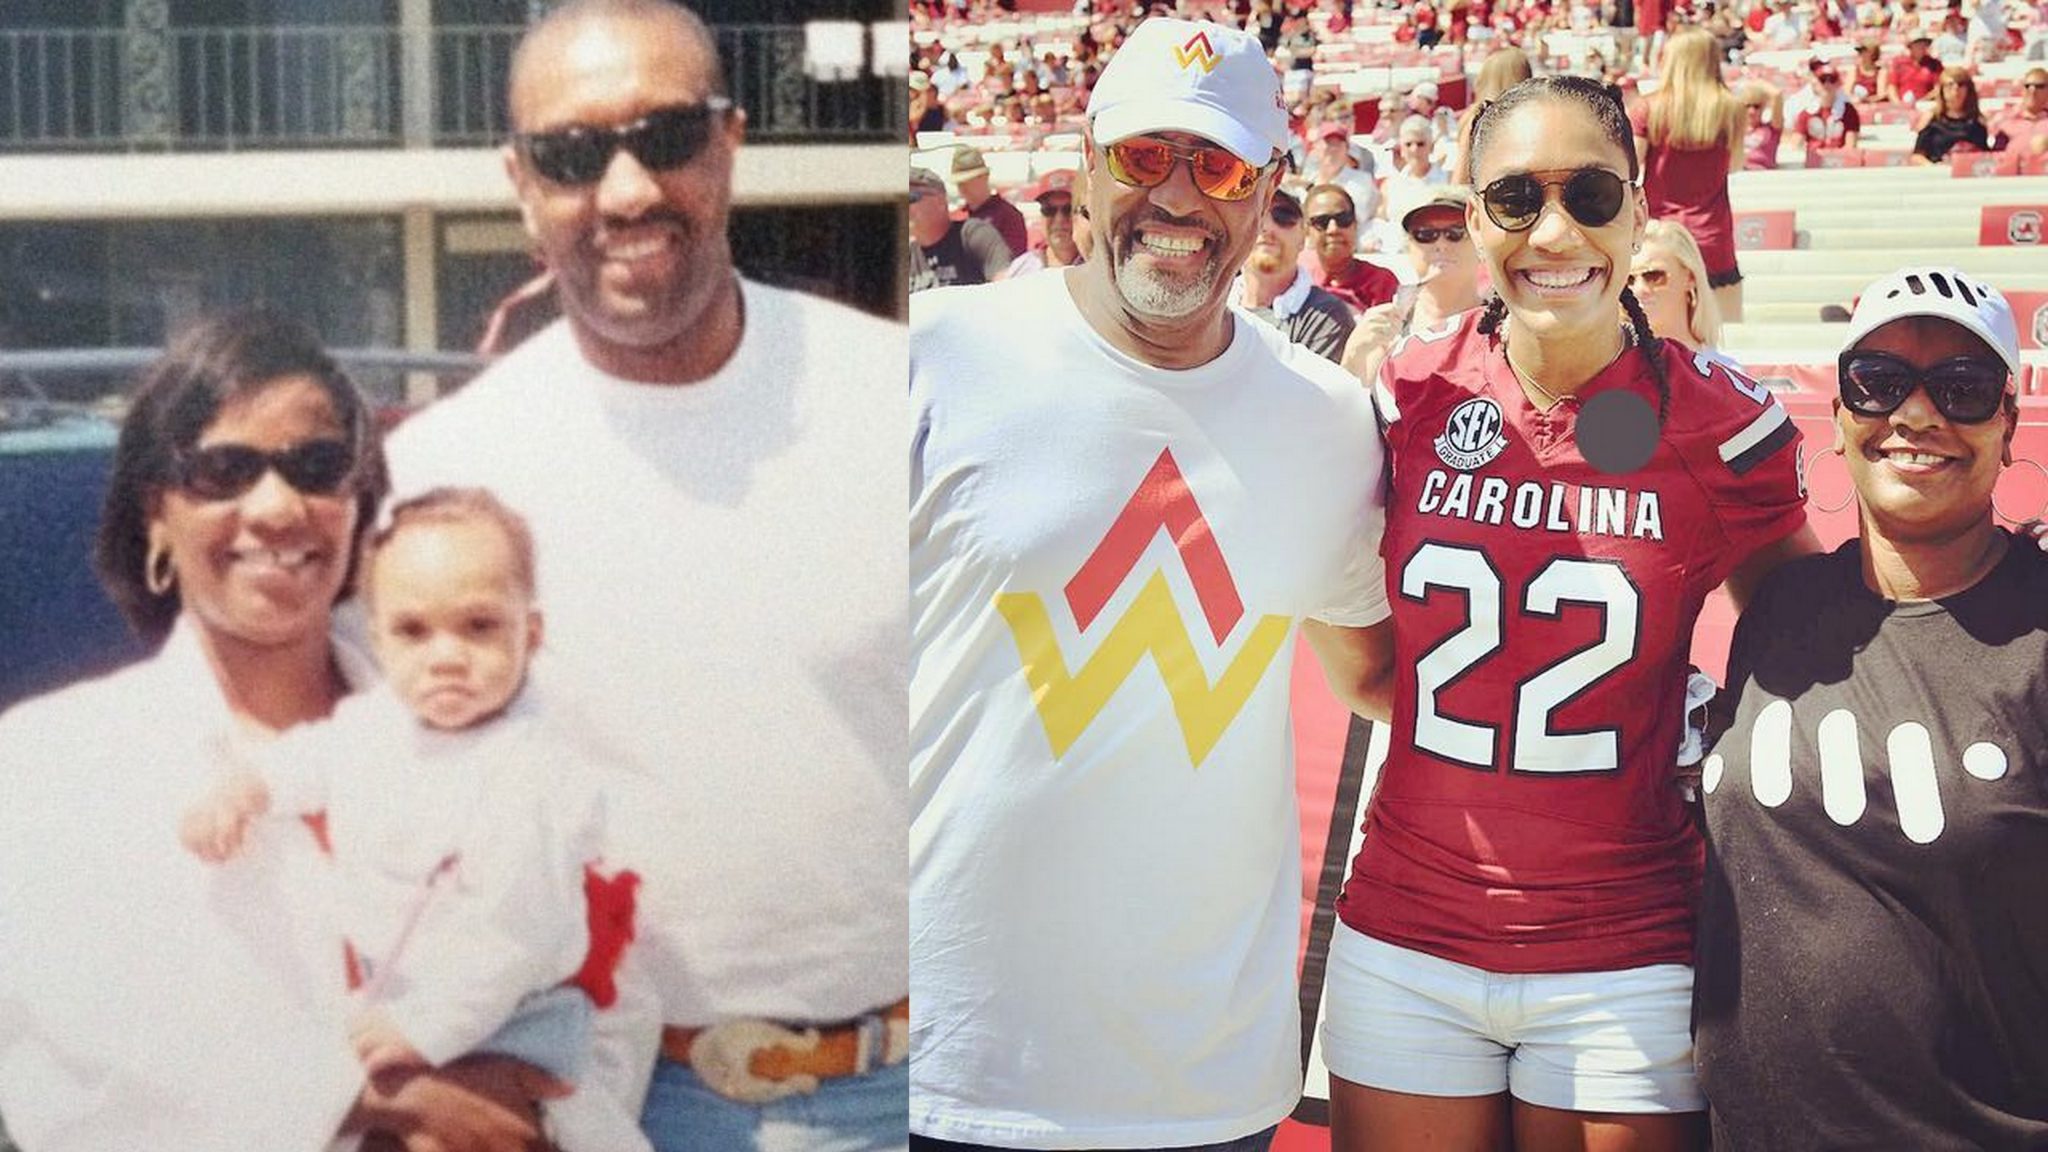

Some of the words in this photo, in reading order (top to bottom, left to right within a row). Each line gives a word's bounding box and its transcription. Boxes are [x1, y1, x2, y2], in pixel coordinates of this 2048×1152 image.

[1438, 445, 1495, 468] GRADUATE
[1449, 401, 1499, 452] SEC
[1418, 469, 1664, 541] CAROLINA
[1400, 539, 1641, 775] 22
